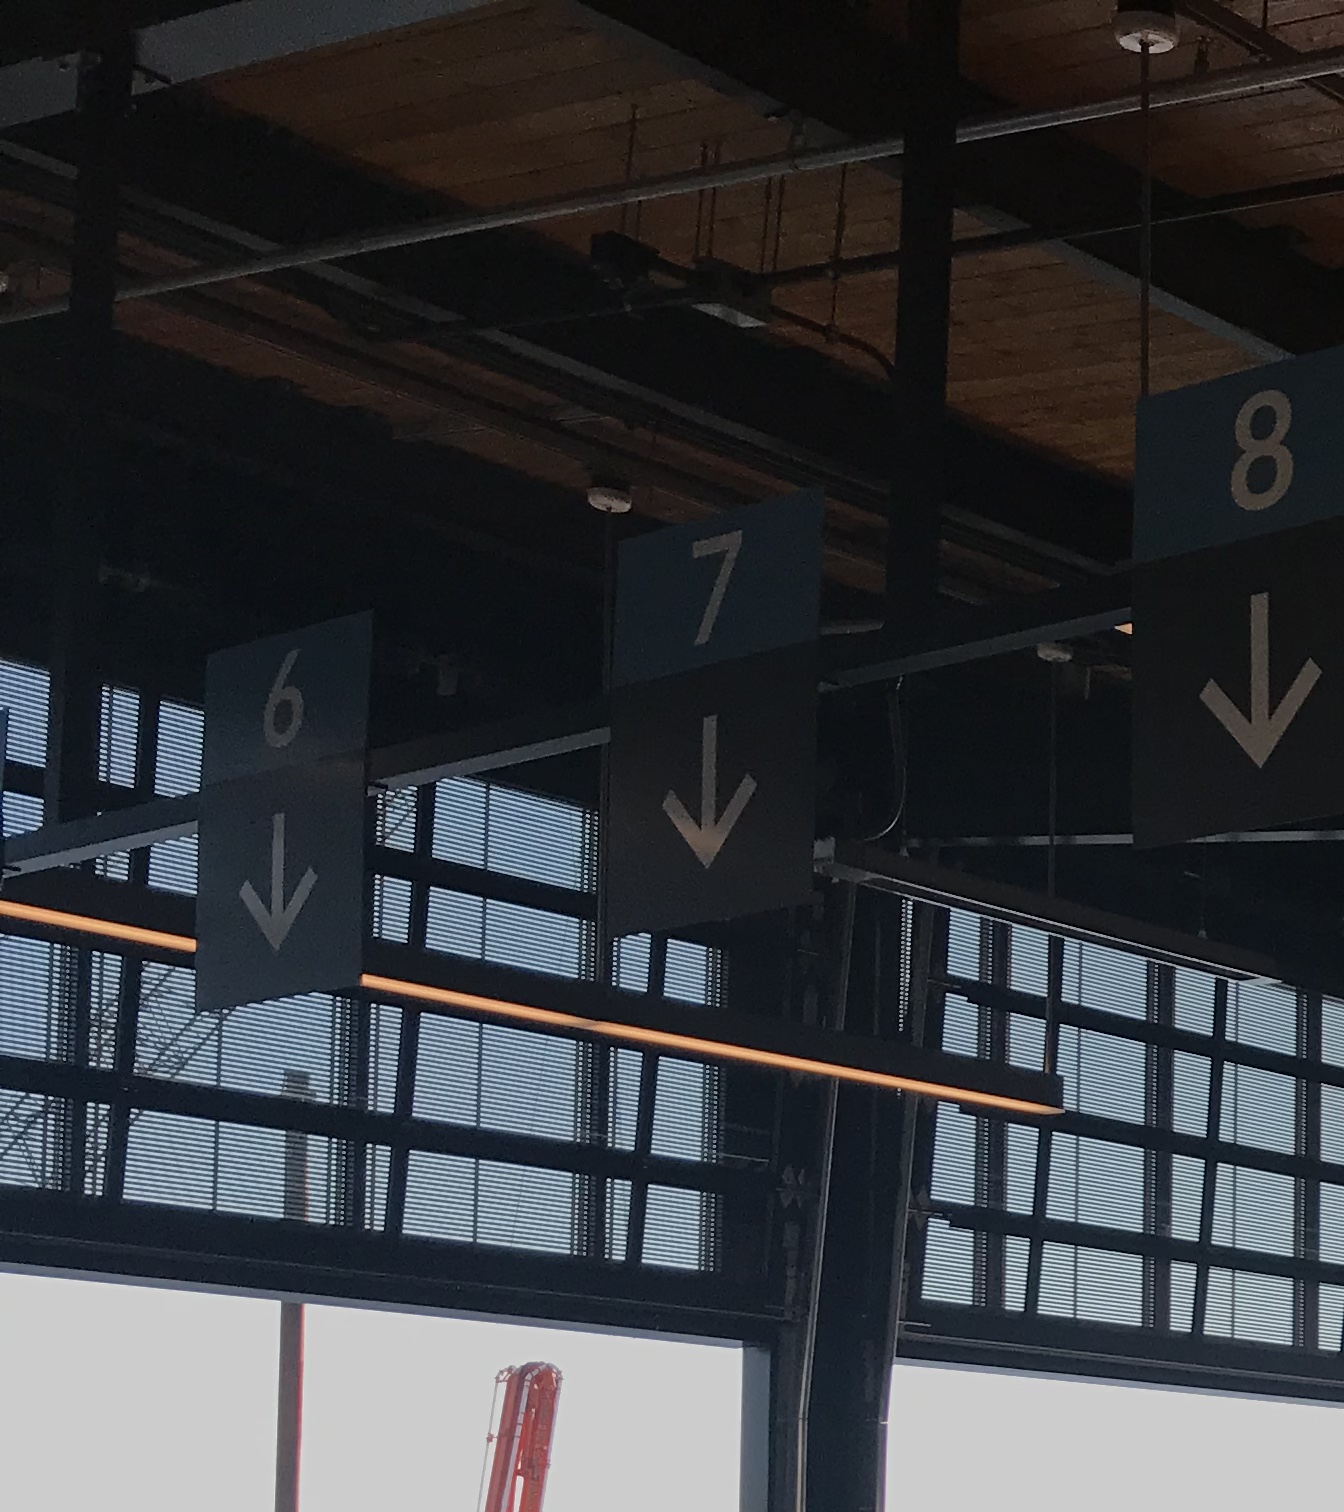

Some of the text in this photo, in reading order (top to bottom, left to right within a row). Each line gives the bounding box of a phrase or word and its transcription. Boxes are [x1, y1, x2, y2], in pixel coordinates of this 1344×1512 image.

[1229, 387, 1294, 513] 8
[690, 529, 745, 647] 7
[262, 648, 306, 751] 6
